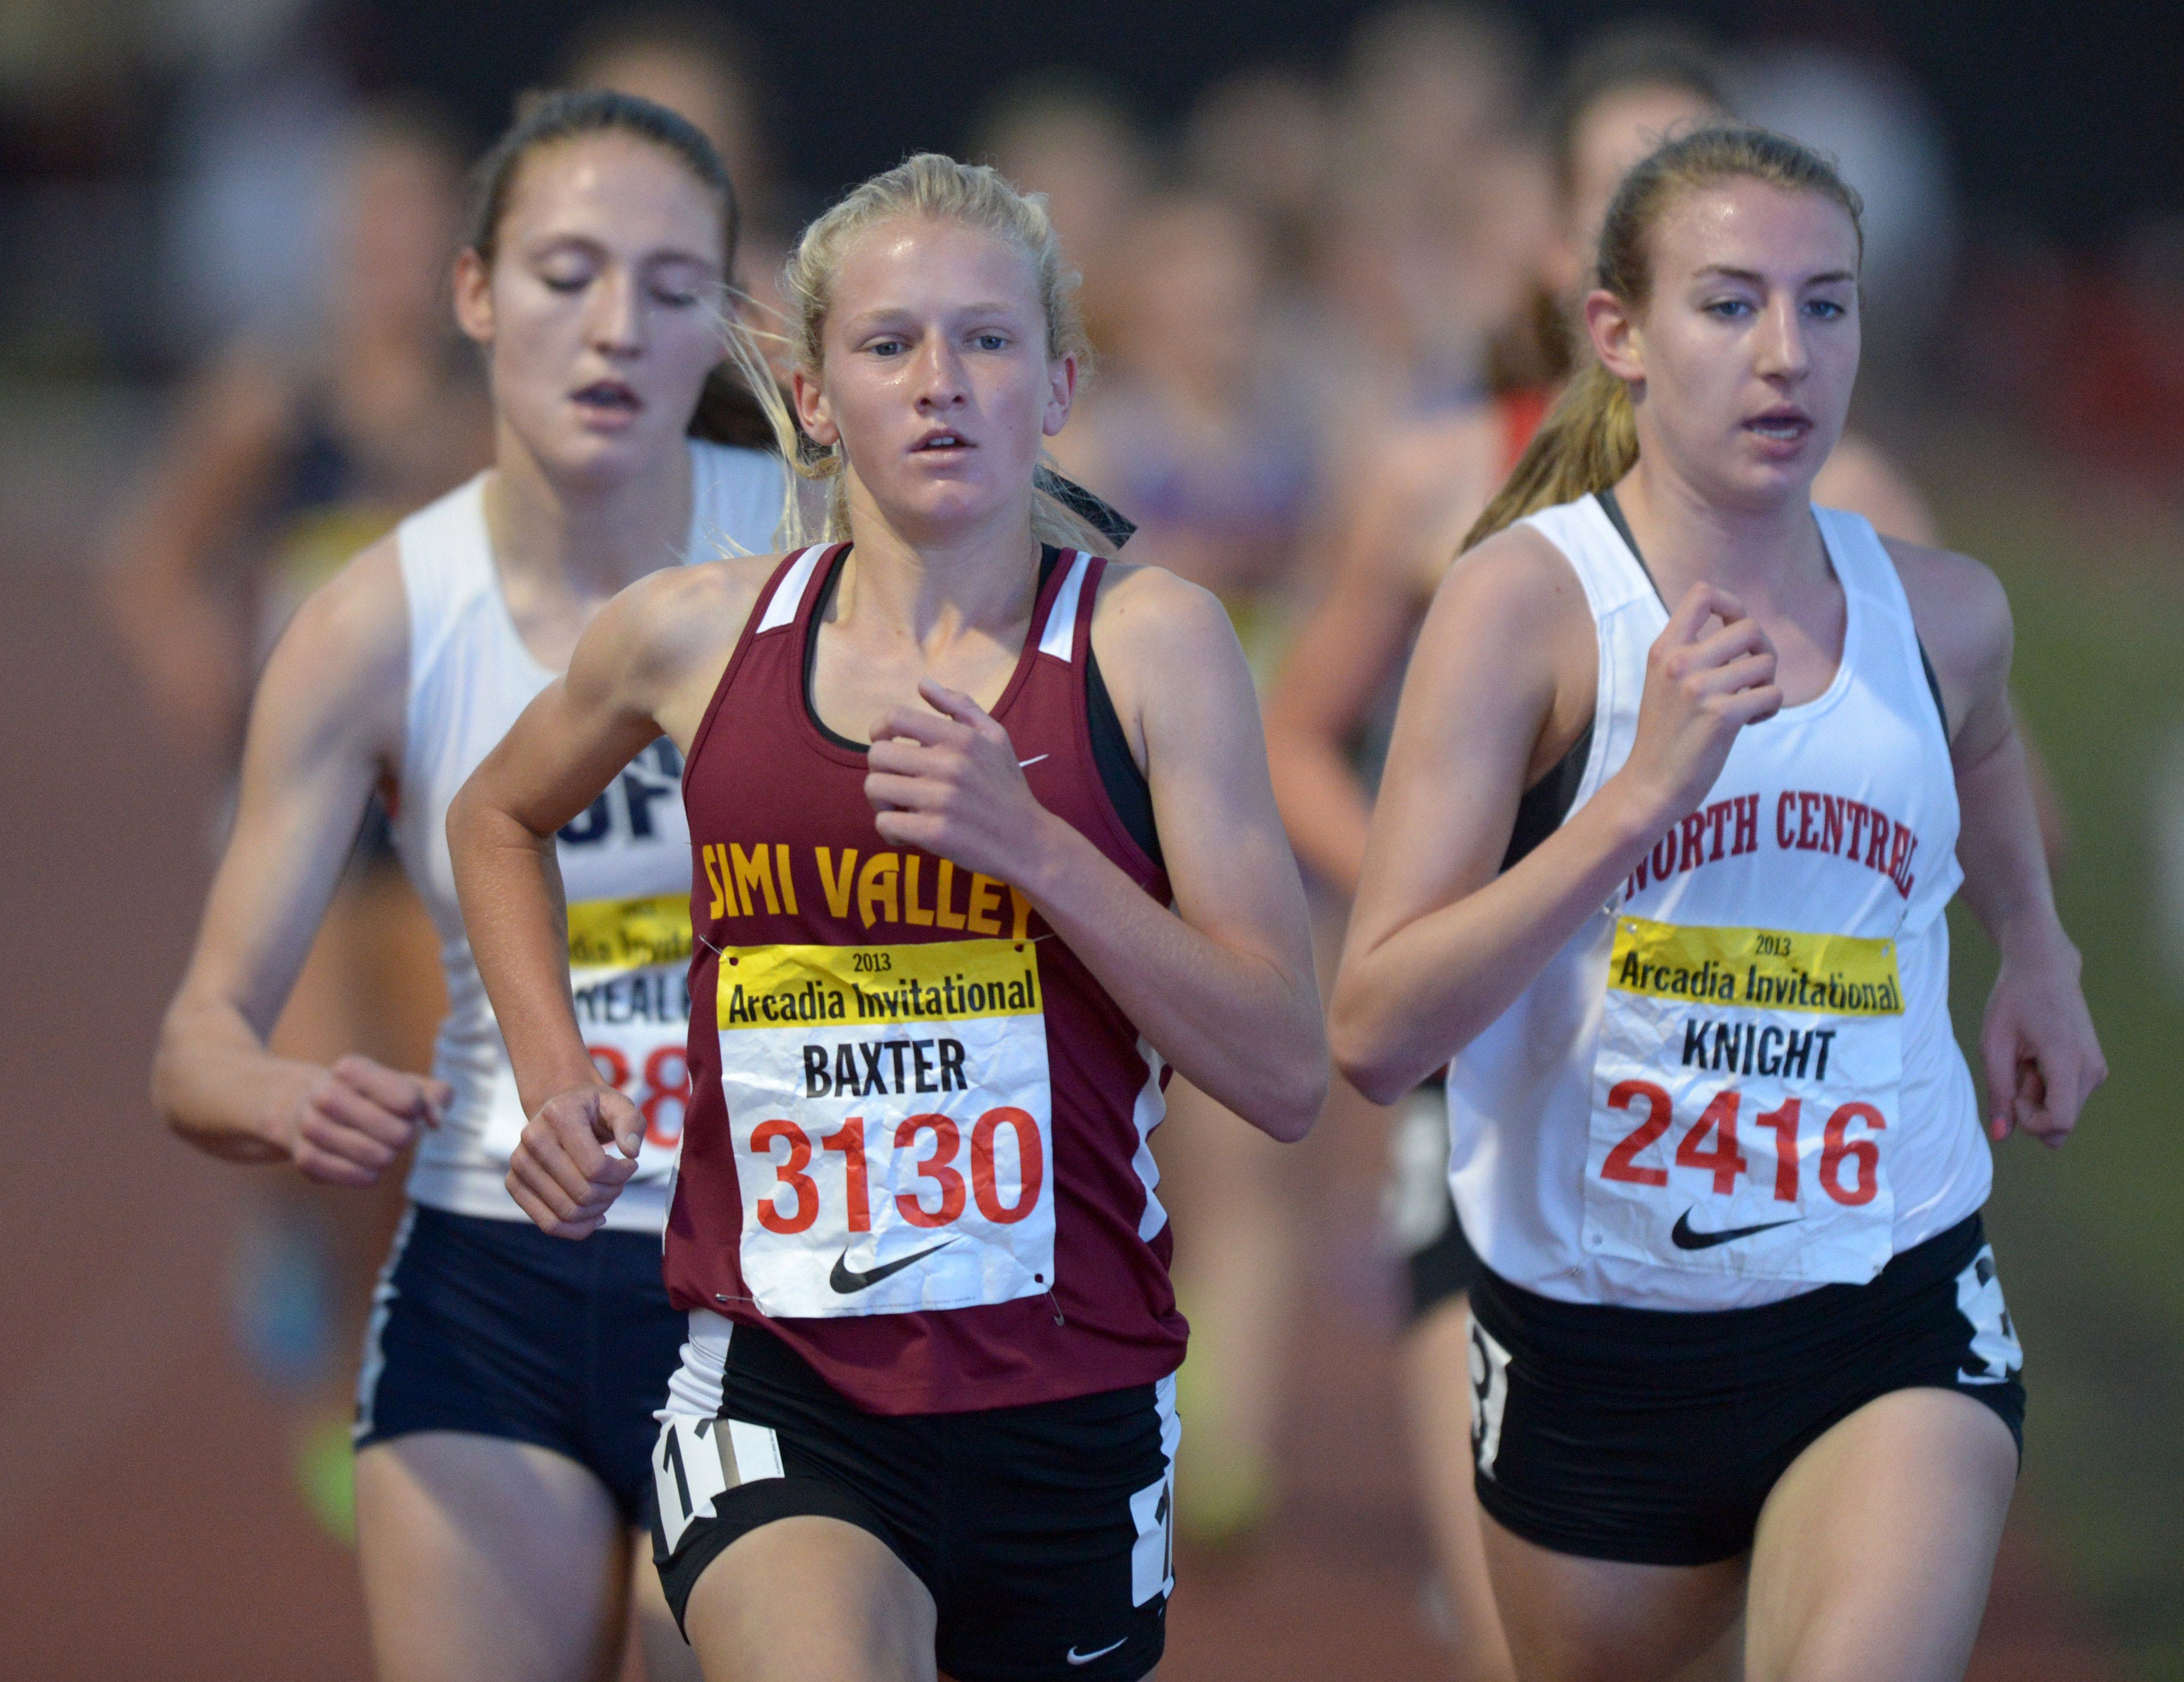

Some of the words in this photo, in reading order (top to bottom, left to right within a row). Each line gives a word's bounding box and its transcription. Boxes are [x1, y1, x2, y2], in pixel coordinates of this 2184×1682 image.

[1776, 789, 1918, 900] CENTRAL
[702, 842, 799, 920] SIMI
[814, 846, 1034, 941] VALLEY
[852, 952, 892, 972] 2013
[1754, 934, 1792, 957] 2013
[728, 979, 846, 1023] Arcadia
[852, 969, 1036, 1018] Invitational
[1619, 950, 1736, 1001] Arcadia
[1745, 964, 1900, 1011] Invitational
[803, 1038, 969, 1099] BAXTER
[1682, 1018, 1837, 1081] KNIGHT
[750, 1106, 1044, 1235] 3130
[1600, 1079, 1887, 1206] 2416
[663, 1418, 742, 1521] 11
